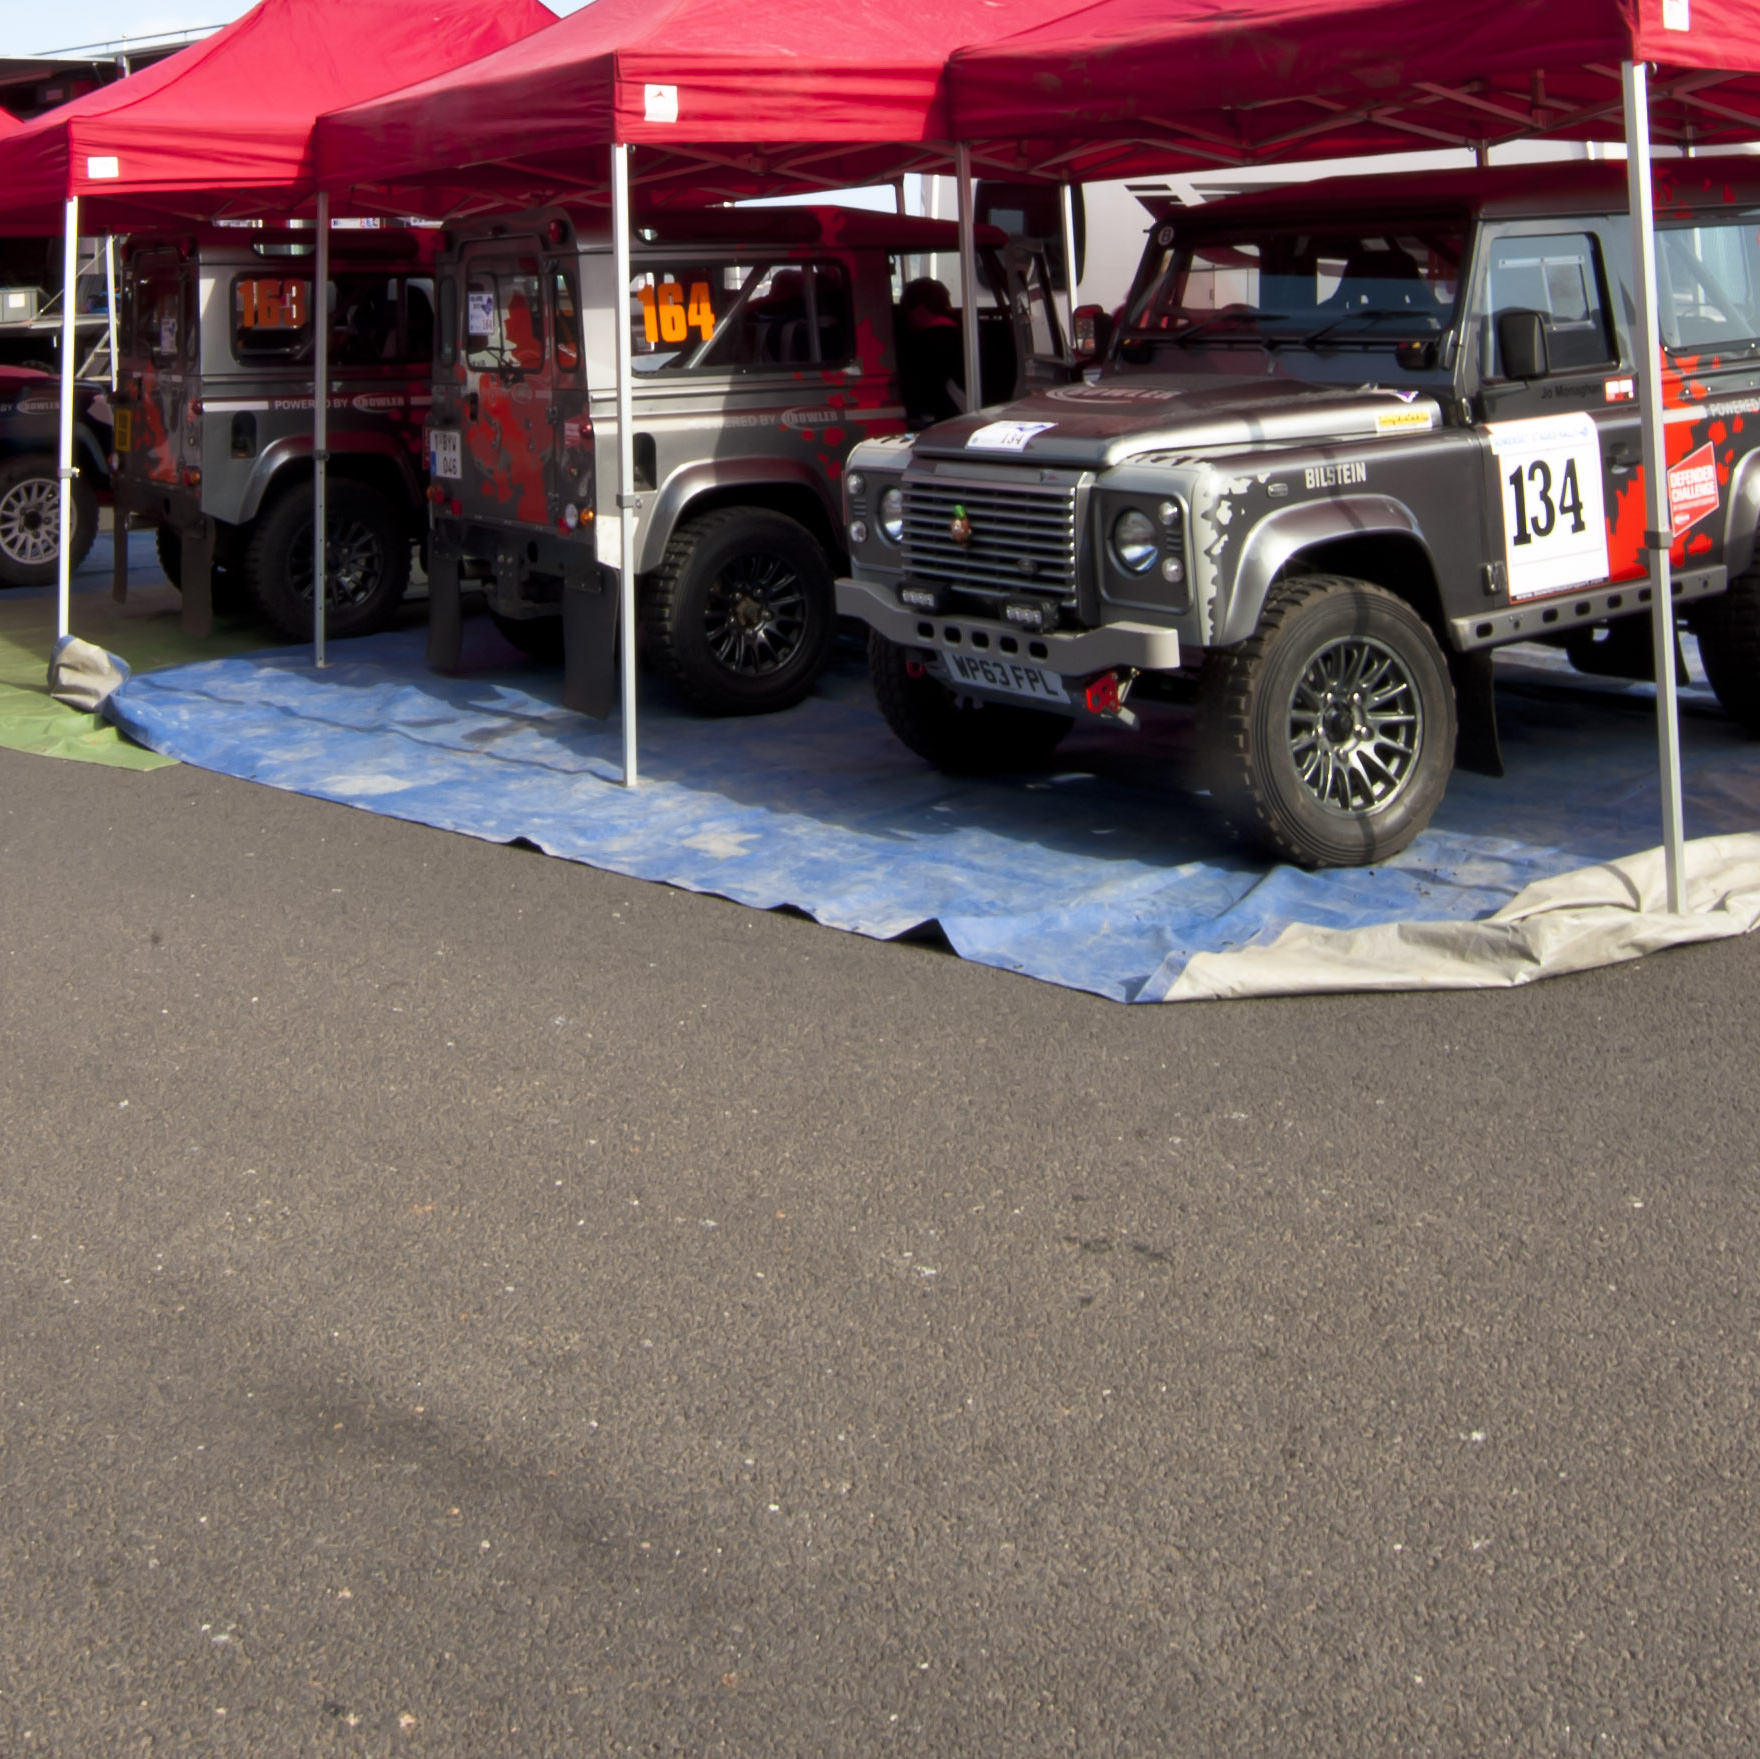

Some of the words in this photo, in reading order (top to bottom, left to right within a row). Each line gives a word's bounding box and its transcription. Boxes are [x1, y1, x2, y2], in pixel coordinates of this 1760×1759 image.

[237, 278, 306, 328] 163
[637, 281, 716, 343] 164
[274, 400, 331, 410] POWERD
[333, 398, 348, 408] BY
[1709, 397, 1759, 417] POWERED
[761, 414, 776, 426] BY
[1304, 461, 1367, 490] BILSTEIN
[1670, 464, 1714, 488] DEFENDER
[1509, 457, 1586, 546] 134
[1671, 481, 1716, 503] CHALLENGE
[951, 653, 1011, 687] WP63
[1010, 664, 1059, 697] FPL
